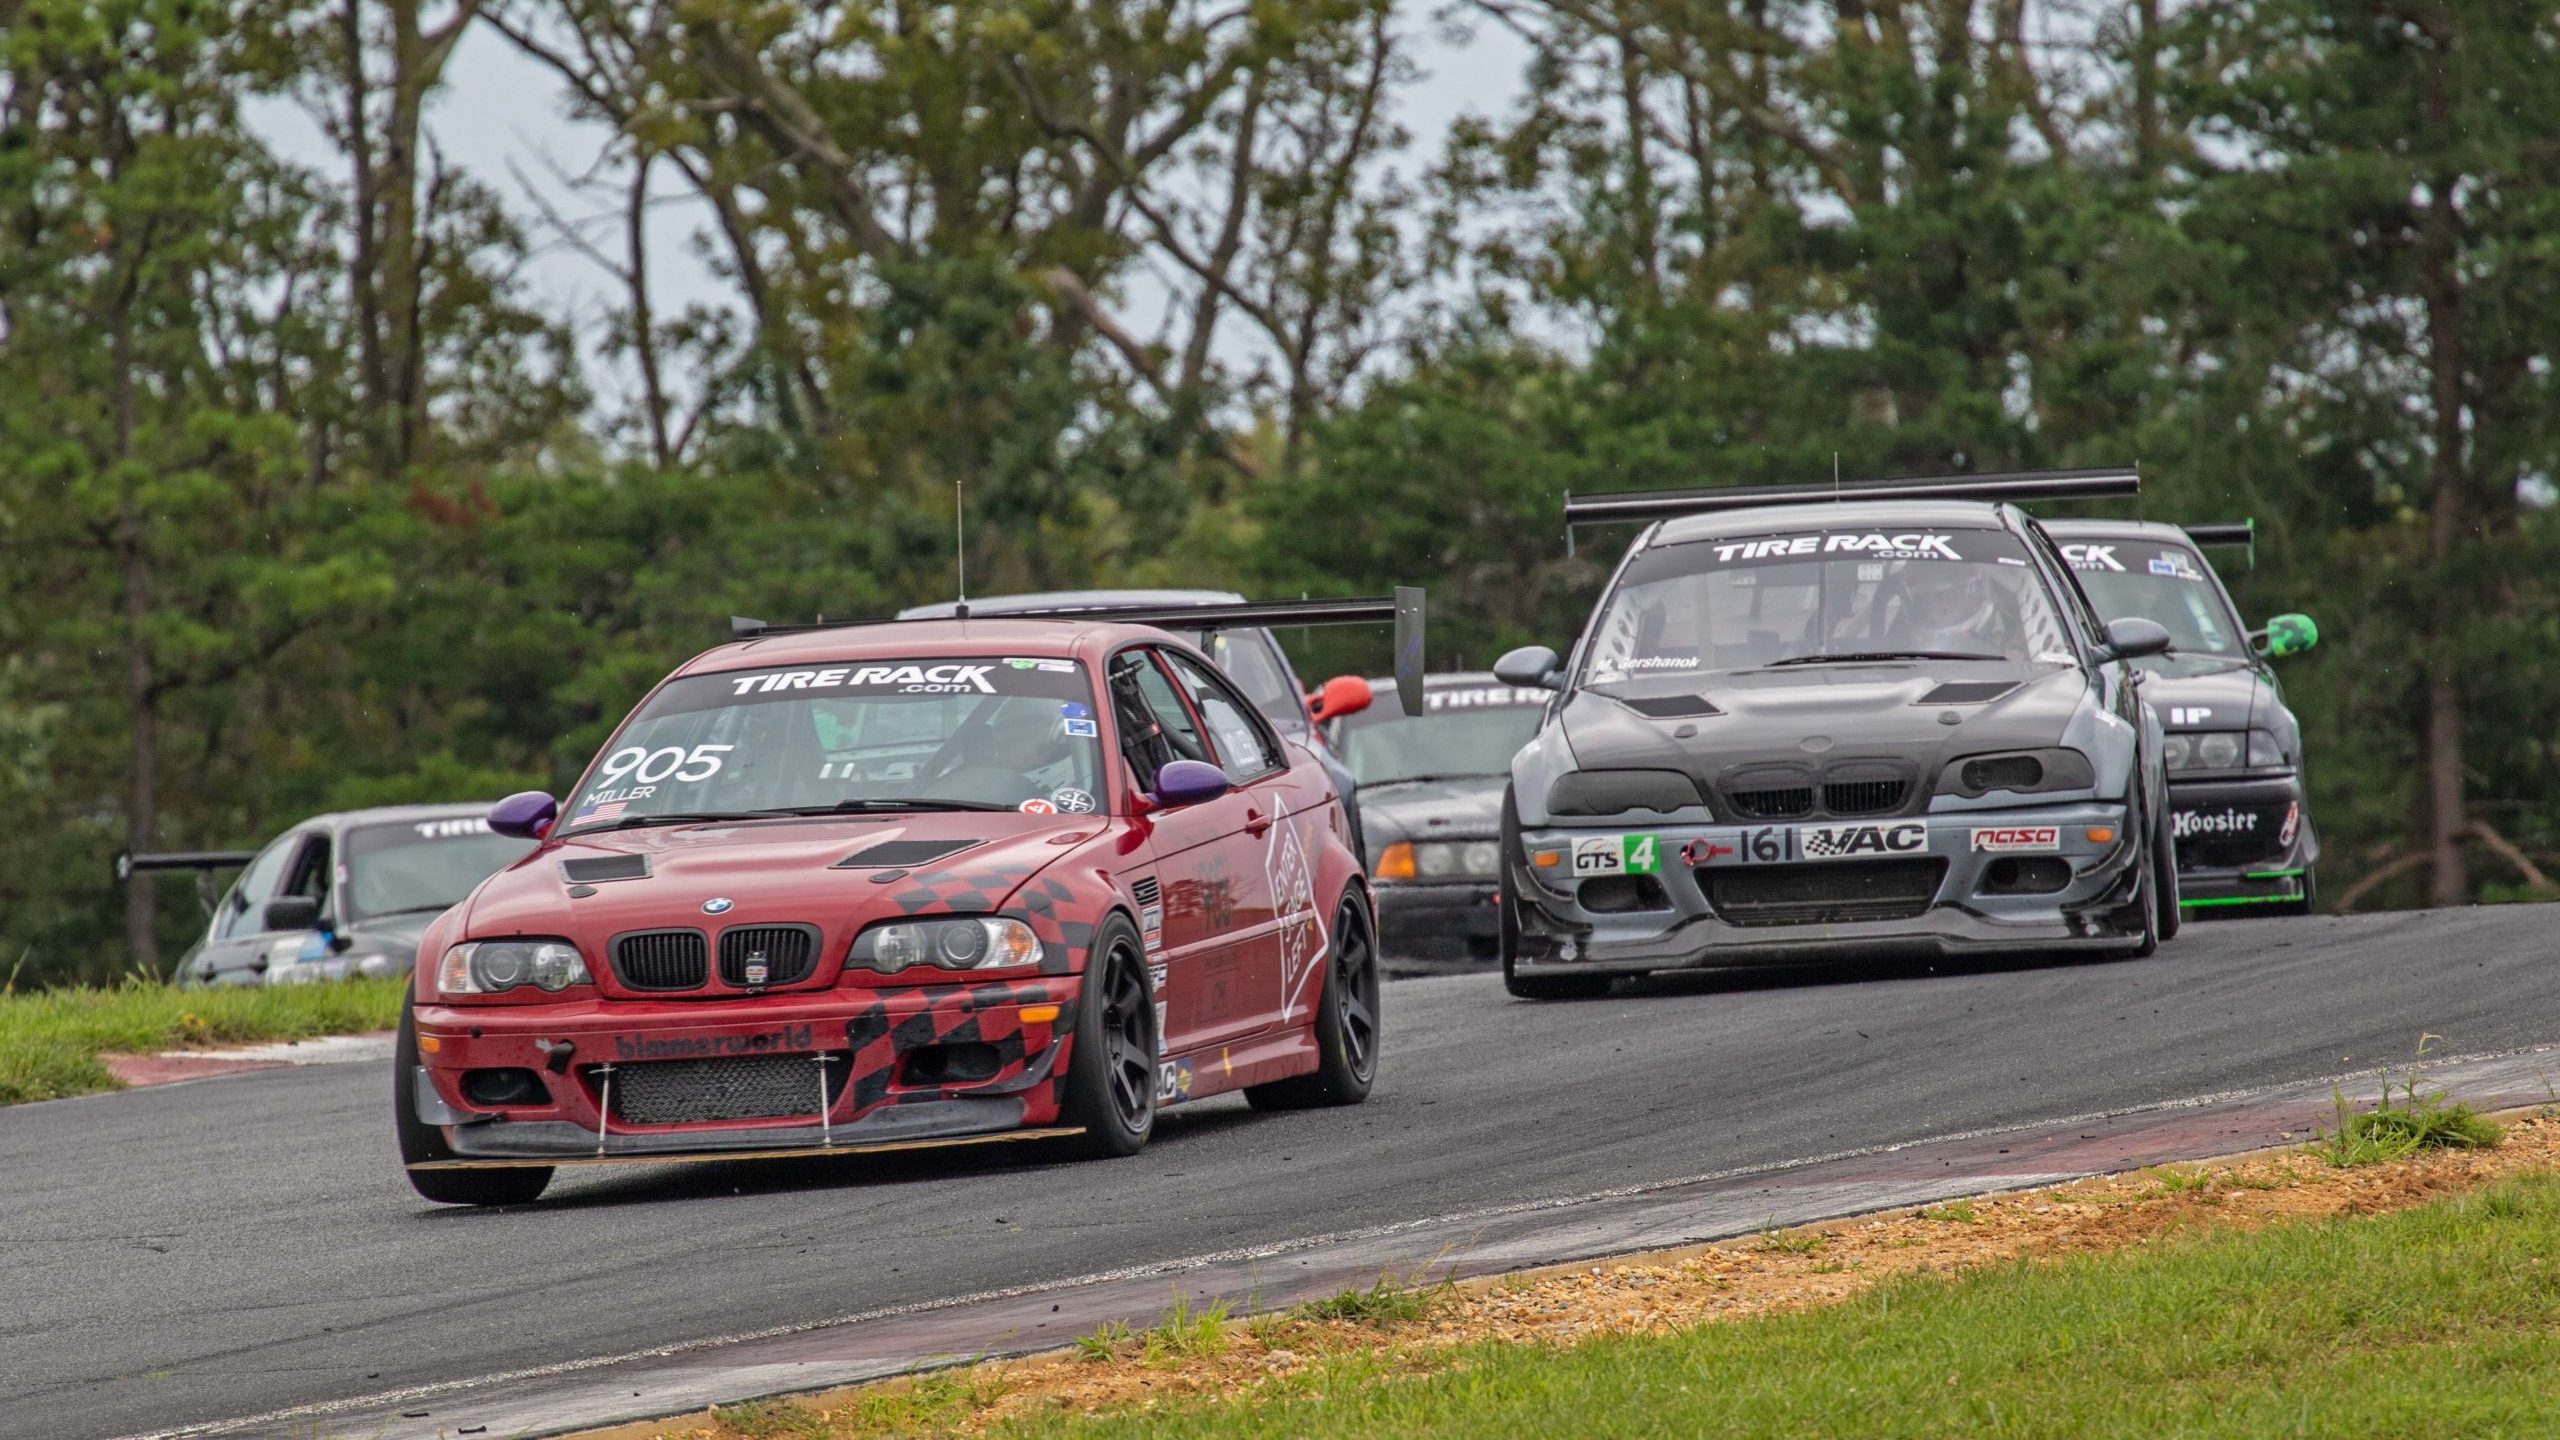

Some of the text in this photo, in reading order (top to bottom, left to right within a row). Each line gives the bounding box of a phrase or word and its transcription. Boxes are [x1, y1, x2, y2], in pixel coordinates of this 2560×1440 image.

[1713, 533, 1962, 562] TIRE RACK
[1872, 550, 1938, 560] .com
[2060, 543, 2127, 573] CK
[732, 664, 998, 696] TIRE RACK
[898, 682, 972, 694] .com
[1423, 687, 1512, 711] TIRE
[2171, 707, 2213, 725] IP
[597, 744, 735, 790] 905
[583, 785, 657, 807] MILLER
[2172, 807, 2258, 837] Hoosier
[1630, 836, 1655, 871] 4
[1740, 827, 1793, 863] 161
[1814, 823, 1925, 855] VAC
[1275, 832, 1298, 907] ENTER
[1576, 850, 1618, 870] GTS
[1286, 922, 1307, 984] LEFT
[615, 1024, 813, 1059] bimmerworld
